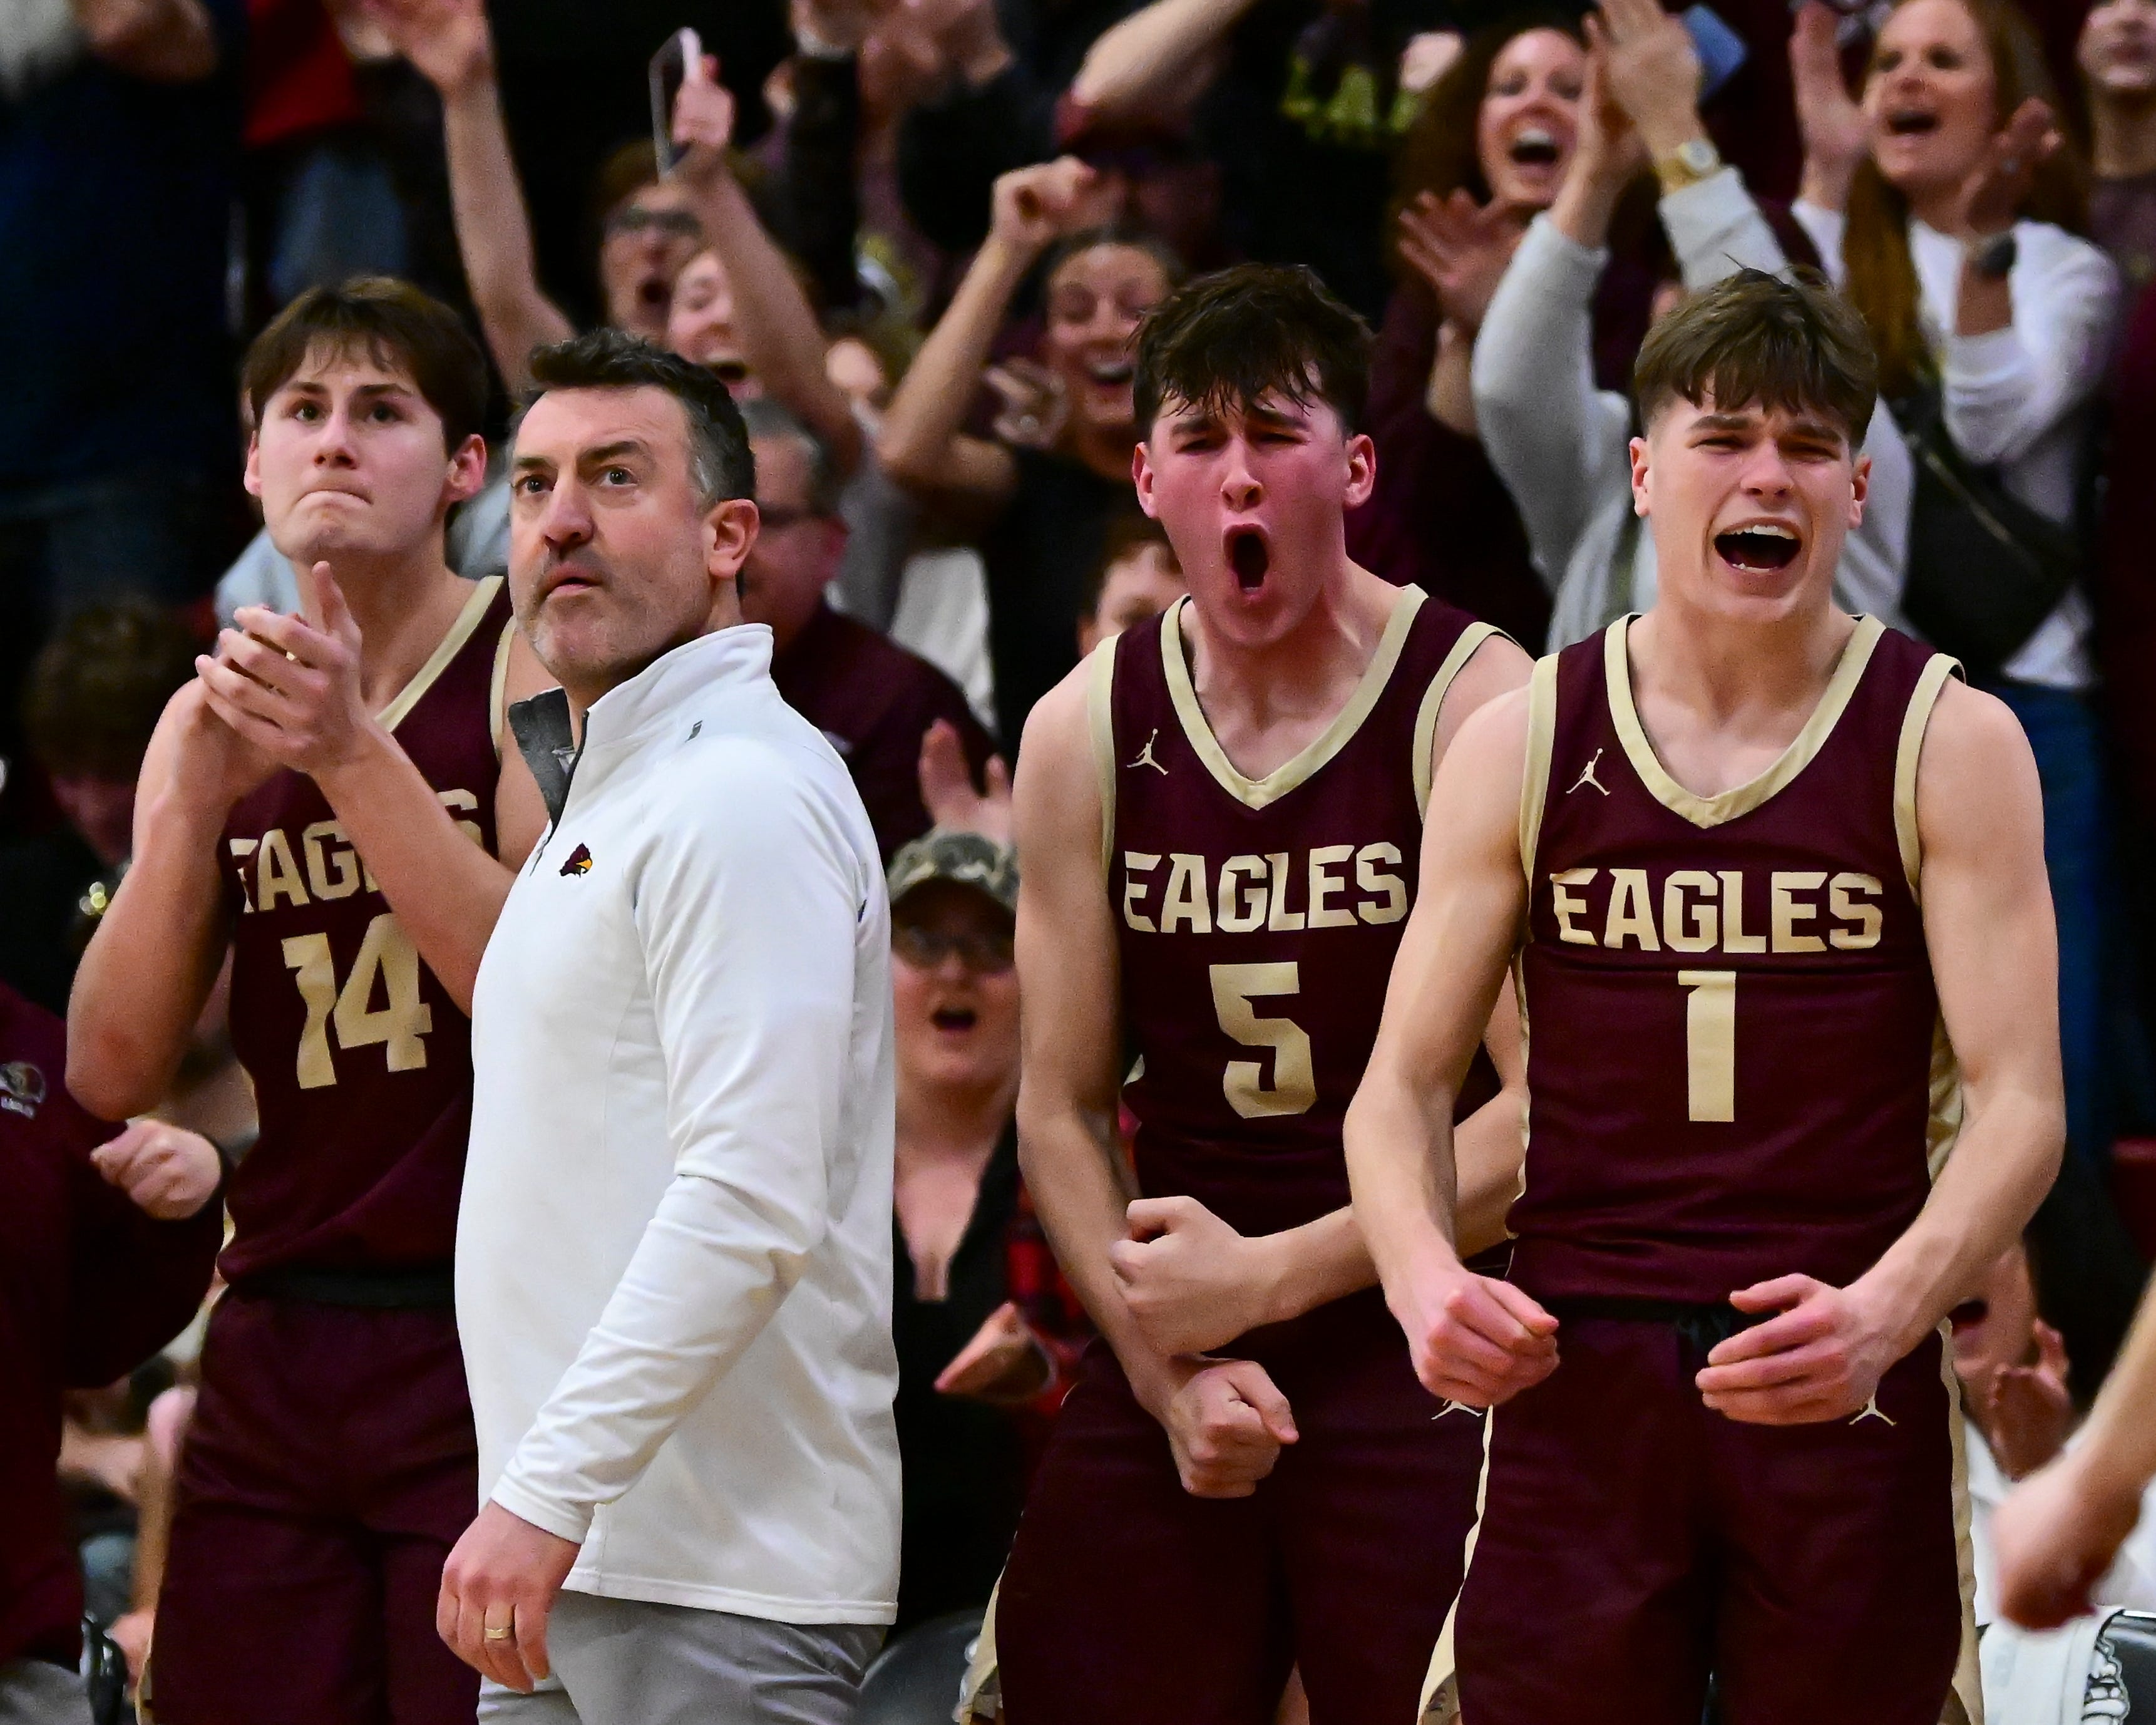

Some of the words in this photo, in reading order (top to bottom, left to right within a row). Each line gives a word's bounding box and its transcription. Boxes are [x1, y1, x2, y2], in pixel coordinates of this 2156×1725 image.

[1124, 842, 1408, 934] EAGLES
[1549, 867, 1883, 954] EAGLES
[281, 912, 433, 1089] 14
[1209, 961, 1318, 1120] 5
[1678, 970, 1737, 1122] 1
